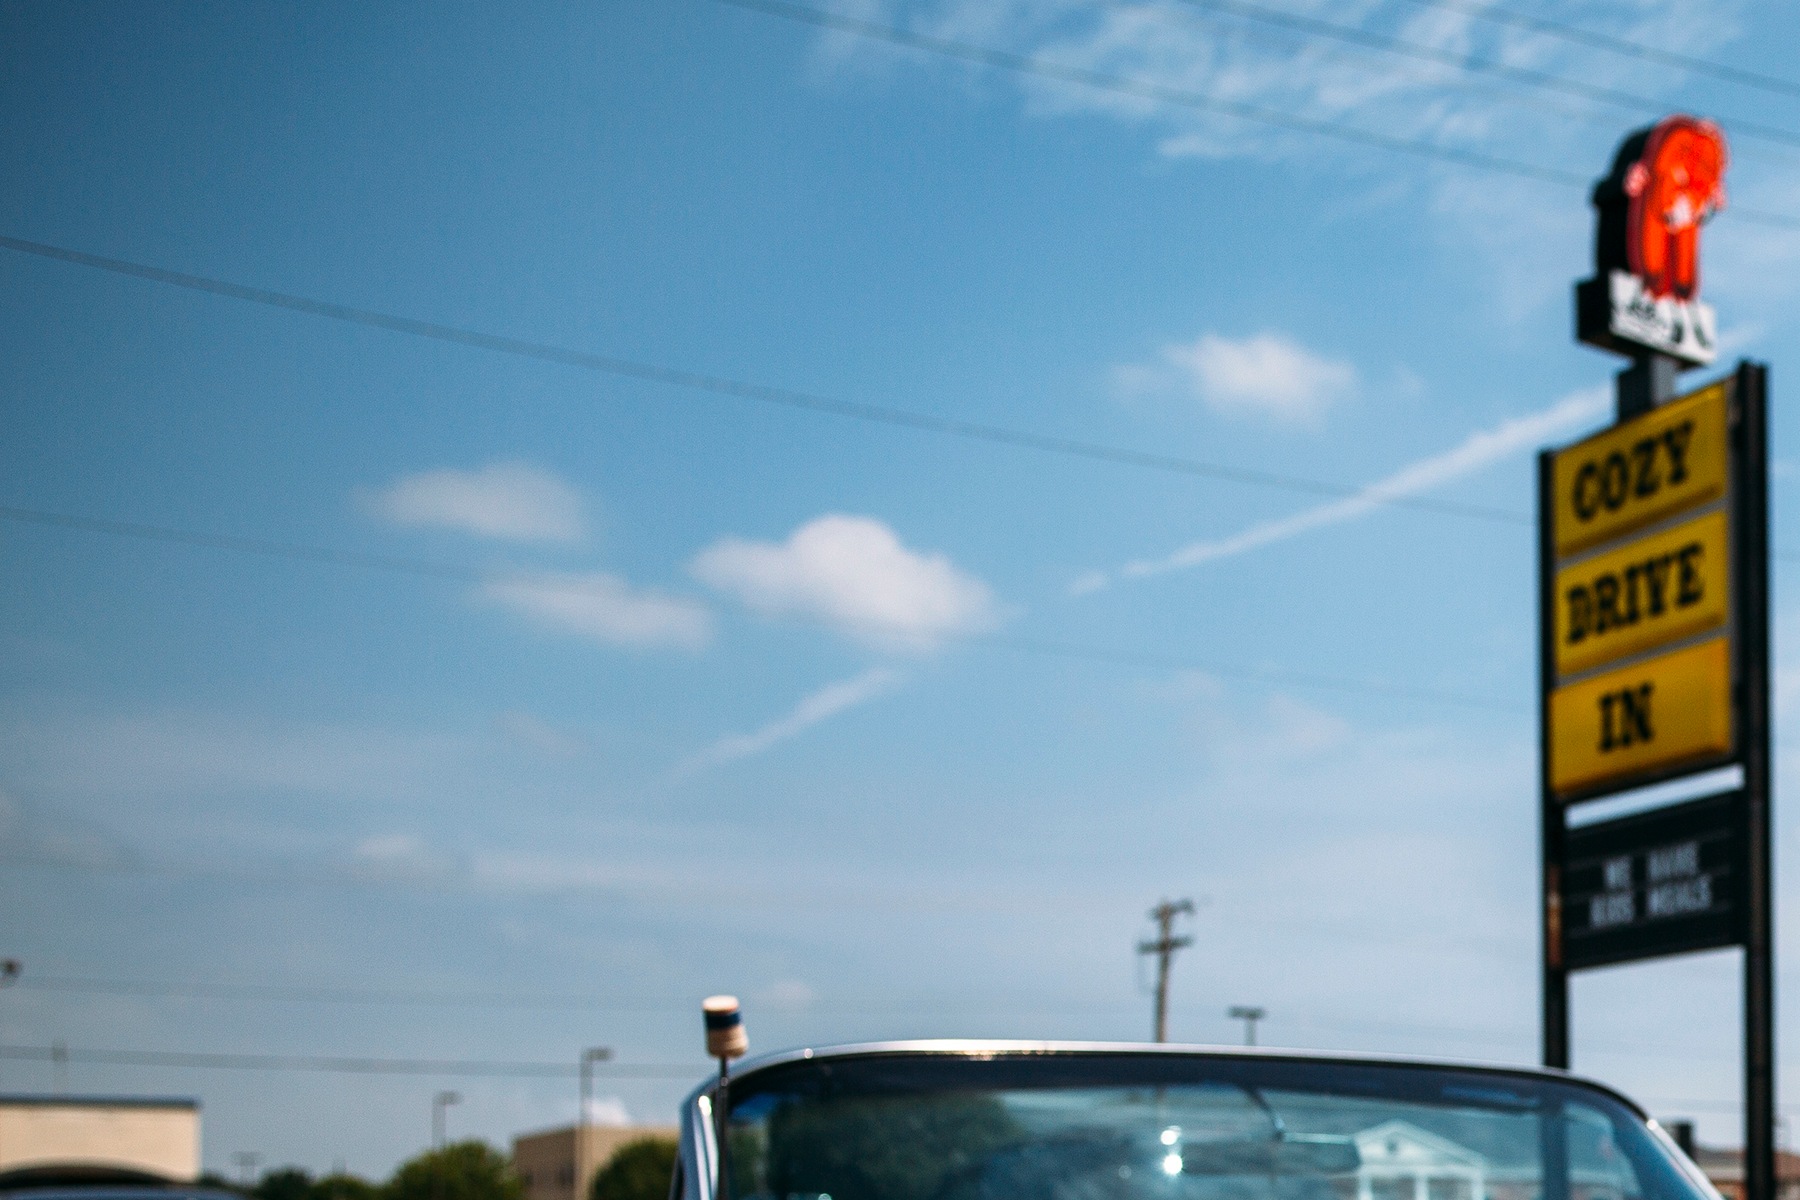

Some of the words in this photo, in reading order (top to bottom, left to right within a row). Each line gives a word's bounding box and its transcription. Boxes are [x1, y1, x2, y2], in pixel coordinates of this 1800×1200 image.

[1571, 420, 1696, 522] COZY
[1566, 543, 1705, 645] DRIVE
[1598, 681, 1655, 753] IN
